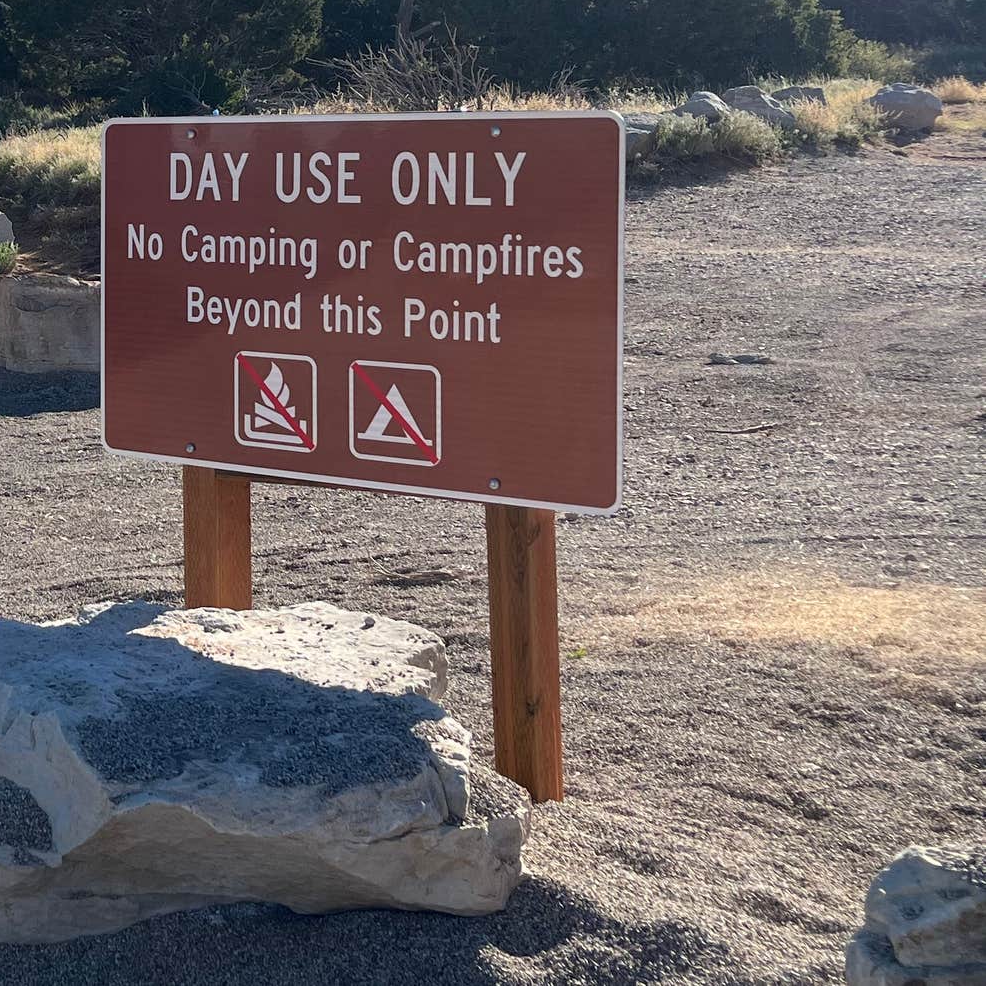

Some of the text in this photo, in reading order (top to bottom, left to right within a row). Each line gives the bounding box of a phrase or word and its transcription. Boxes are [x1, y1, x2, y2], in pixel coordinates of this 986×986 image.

[169, 151, 527, 207] DAY USE ONLY
[126, 223, 585, 285] No Camping or Campfires
[186, 286, 502, 344] Beyond this Point
